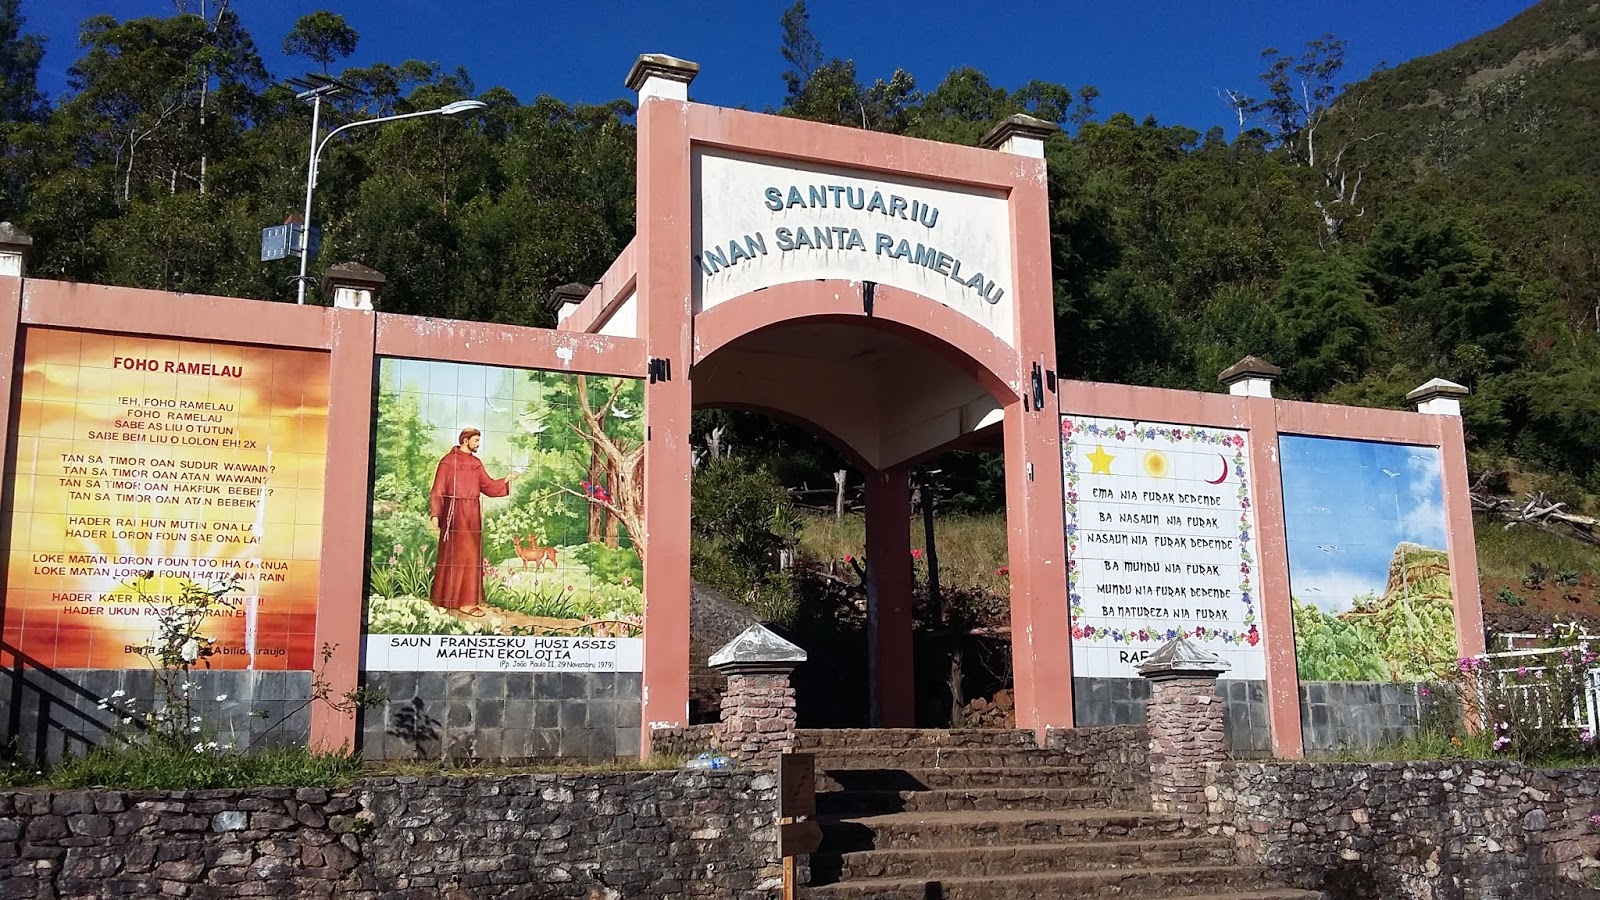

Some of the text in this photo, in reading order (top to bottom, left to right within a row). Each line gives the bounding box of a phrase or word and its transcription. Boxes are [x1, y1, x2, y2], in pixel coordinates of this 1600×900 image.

[764, 184, 939, 229] SANTUARIU
[694, 226, 1005, 305] INAN SANTA RAMELAU
[113, 356, 243, 378] FOHO RAMELAU
[144, 398, 176, 408] FOHO
[179, 400, 234, 412] RAMELAU
[127, 409, 223, 423] FOHO RAMELAU
[114, 420, 234, 435] SABE AS LIU O TUTUN
[88, 431, 257, 449] SABE BEM LIU O LOLON EH! 2X
[61, 454, 85, 463] TAN
[88, 455, 104, 464] SA
[109, 456, 146, 466] TIMOR
[150, 458, 175, 468] OAN
[180, 460, 219, 470] SUDUR
[63, 466, 87, 475] TAN
[92, 467, 108, 476] SA
[112, 468, 149, 478] TIMOR
[152, 471, 178, 480] OAN
[181, 472, 210, 481] ATAN
[59, 479, 274, 497] TAN SA TIMOR OAN HAKRUK BEBEI?
[69, 492, 91, 500] TAN
[95, 493, 111, 501] SA
[116, 494, 151, 503] TIMOR
[155, 496, 180, 505] OAN
[185, 497, 213, 506] ATAN
[1093, 488, 1221, 507] EMA NIA FURAK DEPENDE
[70, 517, 111, 526] HADER
[116, 519, 137, 527] RAI
[141, 520, 167, 528] HUN
[171, 520, 207, 530] MUTIN
[213, 522, 238, 531] ONA
[1099, 512, 1113, 523] BA
[1119, 513, 1160, 526] NASAUN
[1166, 516, 1182, 527] NIA
[66, 529, 107, 539] HADER
[112, 531, 153, 540] LORON
[156, 532, 187, 541] FOUN
[191, 534, 213, 543] SAE
[216, 535, 241, 544] ONA
[1087, 533, 1233, 551] NASAUN NIA FURAK DEPENDE
[33, 554, 65, 563] LOKE
[69, 555, 108, 565] MATAN
[114, 557, 153, 566] LORON
[158, 558, 189, 567] FOUN
[193, 559, 218, 568] TO'O
[222, 560, 241, 569] IHA
[1104, 561, 1120, 572] BA
[1124, 562, 1160, 573] MUNDU
[1165, 564, 1181, 574] NIA
[34, 567, 66, 576] LOKE
[70, 568, 110, 577] MATAN
[115, 569, 155, 578] LORO
[160, 570, 191, 579] FOUN
[193, 571, 214, 580] IHA
[260, 573, 285, 582] RAIN
[53, 593, 93, 602] HADER
[100, 594, 133, 603] KA'ER
[139, 595, 173, 604] RASIK
[212, 597, 243, 606] TALIN
[1097, 584, 1231, 600] MUNDU NIA FURAK DEPENDE
[64, 606, 104, 615] HADER
[109, 607, 140, 616] UKUN
[144, 608, 179, 617] RASIK
[206, 609, 233, 618] RAIN
[1102, 606, 1115, 617] BA
[1118, 607, 1170, 619] NATUREZA
[1173, 608, 1190, 619] NIA
[390, 638, 617, 650] SAUN FRANSISKU HUSI ASSIS
[250, 647, 286, 657] raujo
[436, 648, 572, 661] MAHEIN EKOLOJIA
[558, 661, 567, 669] 29
[598, 662, 615, 670] 1979)
